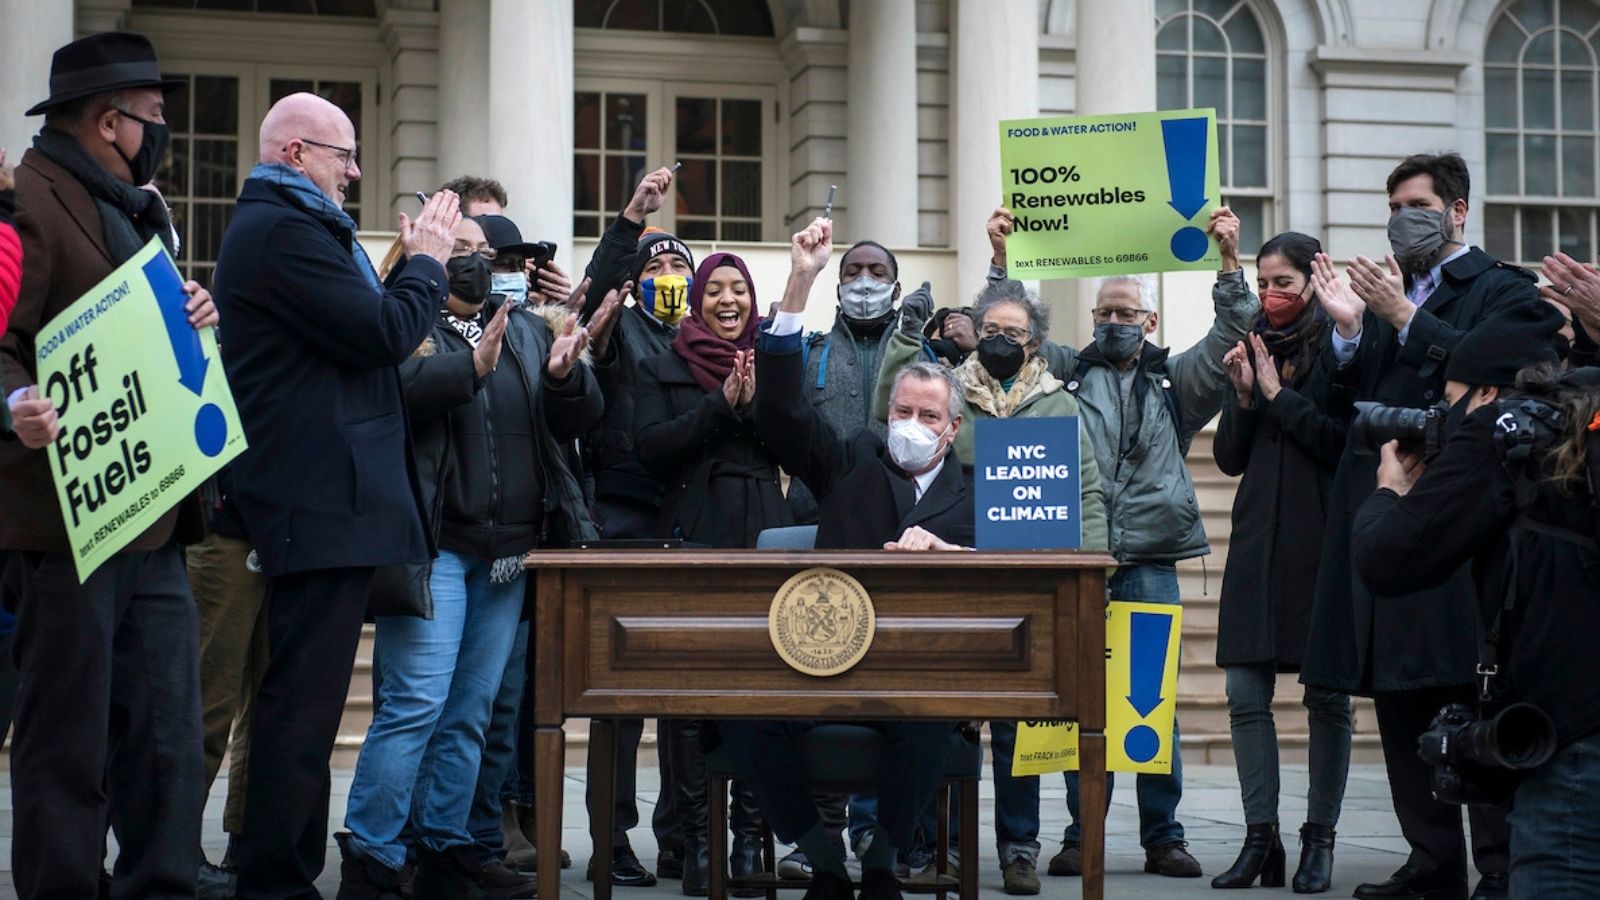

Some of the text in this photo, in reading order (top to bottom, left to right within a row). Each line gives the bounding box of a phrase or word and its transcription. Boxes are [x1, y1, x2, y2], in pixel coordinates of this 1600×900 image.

[1008, 121, 1137, 138] FOOD & WATER ACTION!
[1010, 165, 1081, 185] 100%
[1011, 187, 1146, 209] Renewables
[1012, 214, 1069, 233] Now!
[650, 240, 670, 257] NEW
[1015, 253, 1149, 268] text RENEWABLES to 69866
[38, 336, 59, 362] FOOD
[64, 308, 96, 338] WATER
[96, 280, 131, 317] ACTION!
[46, 343, 98, 419] Off
[55, 370, 147, 477] Fossil
[1007, 445, 1047, 460] NYC
[985, 464, 1069, 480] LEADING
[65, 438, 152, 529] Fuels
[1012, 486, 1042, 500] ON
[986, 506, 1069, 521] CLIMATE
[79, 539, 95, 559] text
[94, 493, 152, 545] RENEWABLES
[150, 488, 160, 500] to
